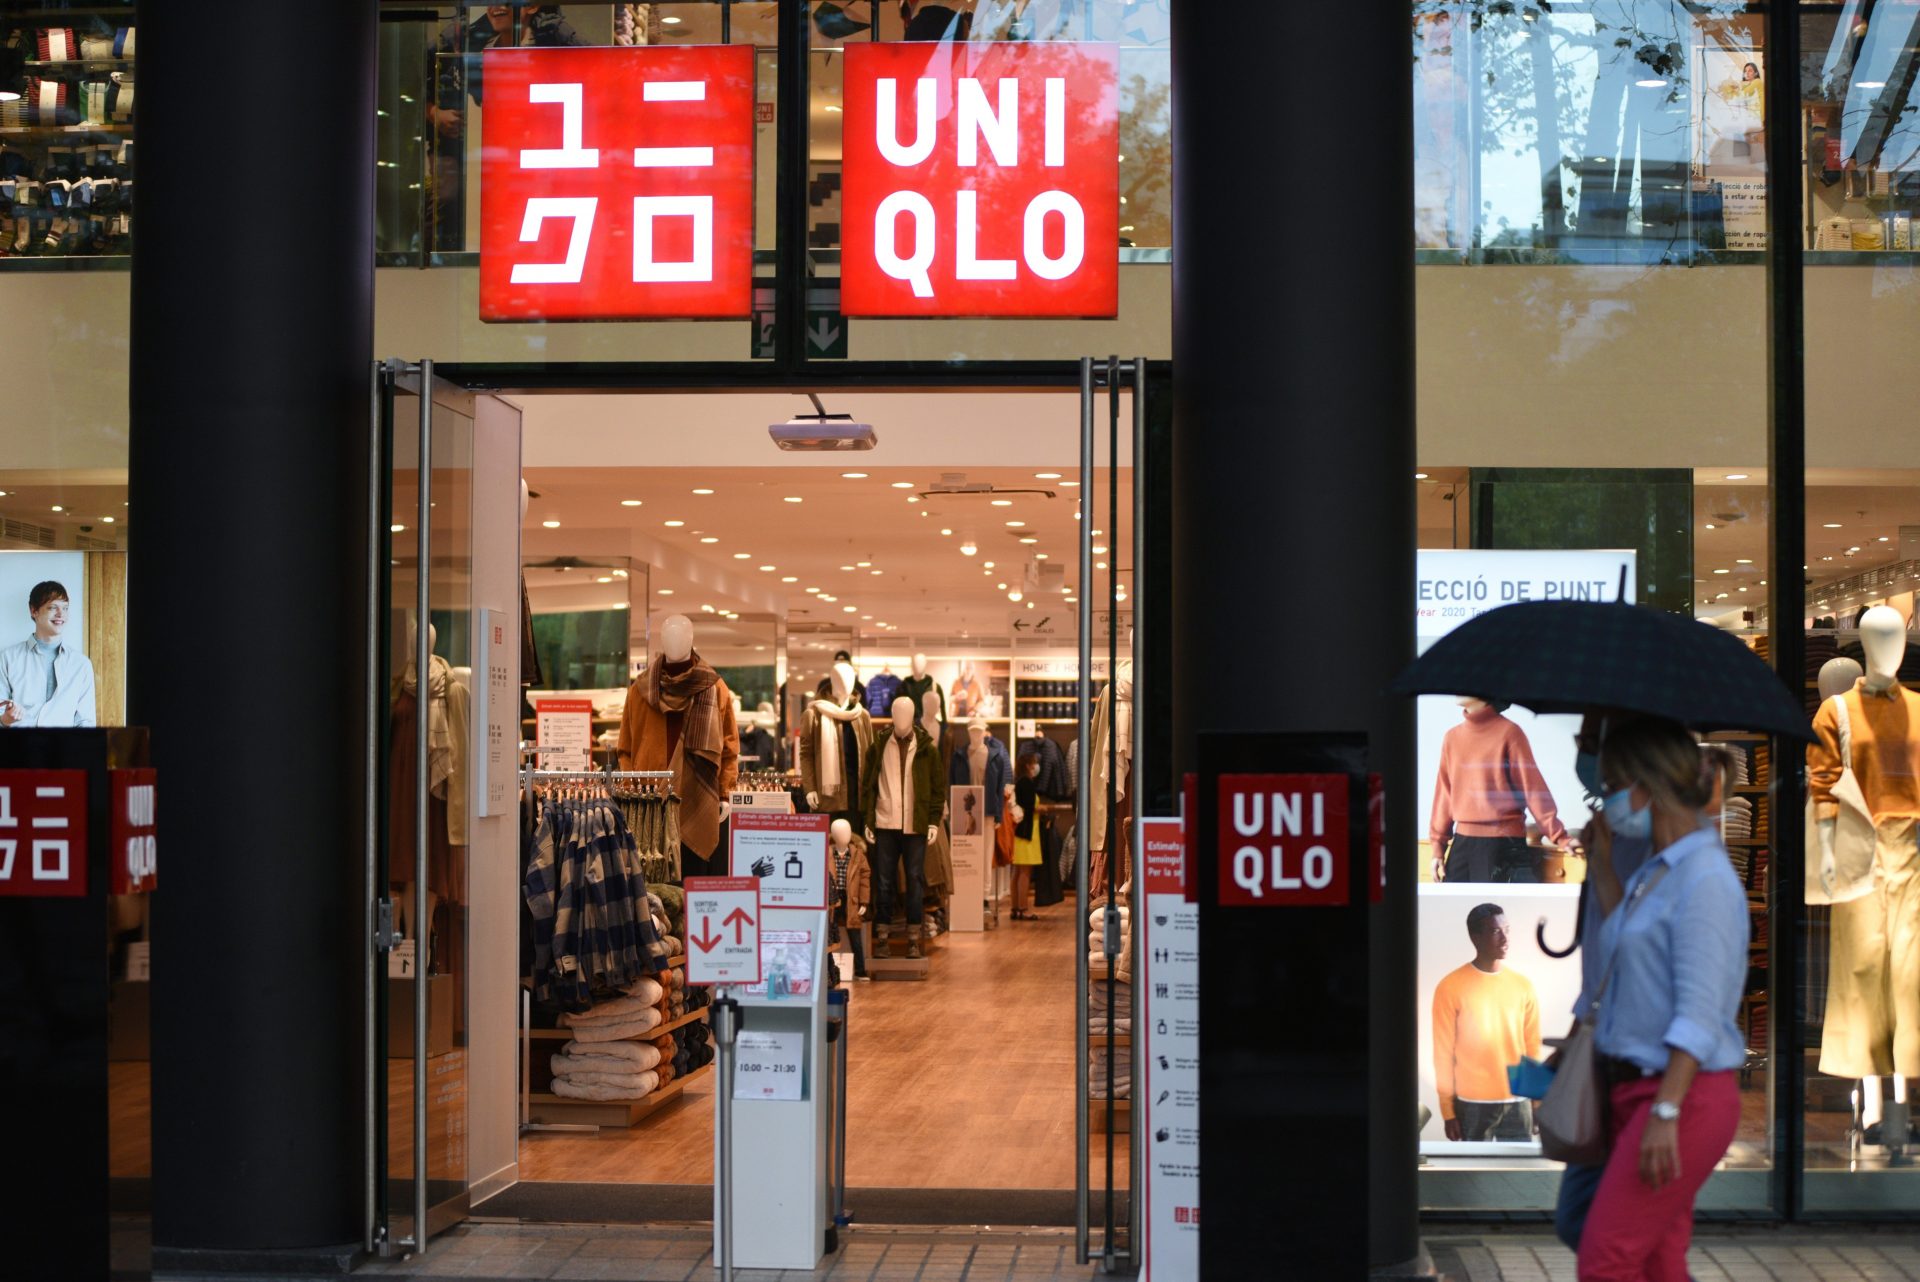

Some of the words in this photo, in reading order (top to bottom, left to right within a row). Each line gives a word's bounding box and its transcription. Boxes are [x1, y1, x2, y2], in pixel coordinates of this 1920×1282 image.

[520, 80, 713, 169] ユニ
[875, 77, 1066, 168] UNI
[1743, 182, 1751, 190] de
[509, 195, 713, 284] クロ
[874, 189, 1085, 298] QLO
[1419, 574, 1488, 601] ECCIÓ
[1501, 580, 1531, 601] DE
[1544, 580, 1607, 602] PUNT
[1442, 607, 1466, 616] 2020
[1023, 664, 1050, 672] HOME
[1064, 664, 1104, 672] HORE
[1233, 792, 1325, 837] UNI
[1148, 866, 1161, 876] Per
[1164, 867, 1172, 876] la
[1233, 845, 1334, 898] QLO
[739, 1064, 762, 1072] 10:00
[773, 1064, 796, 1072] 21:30
